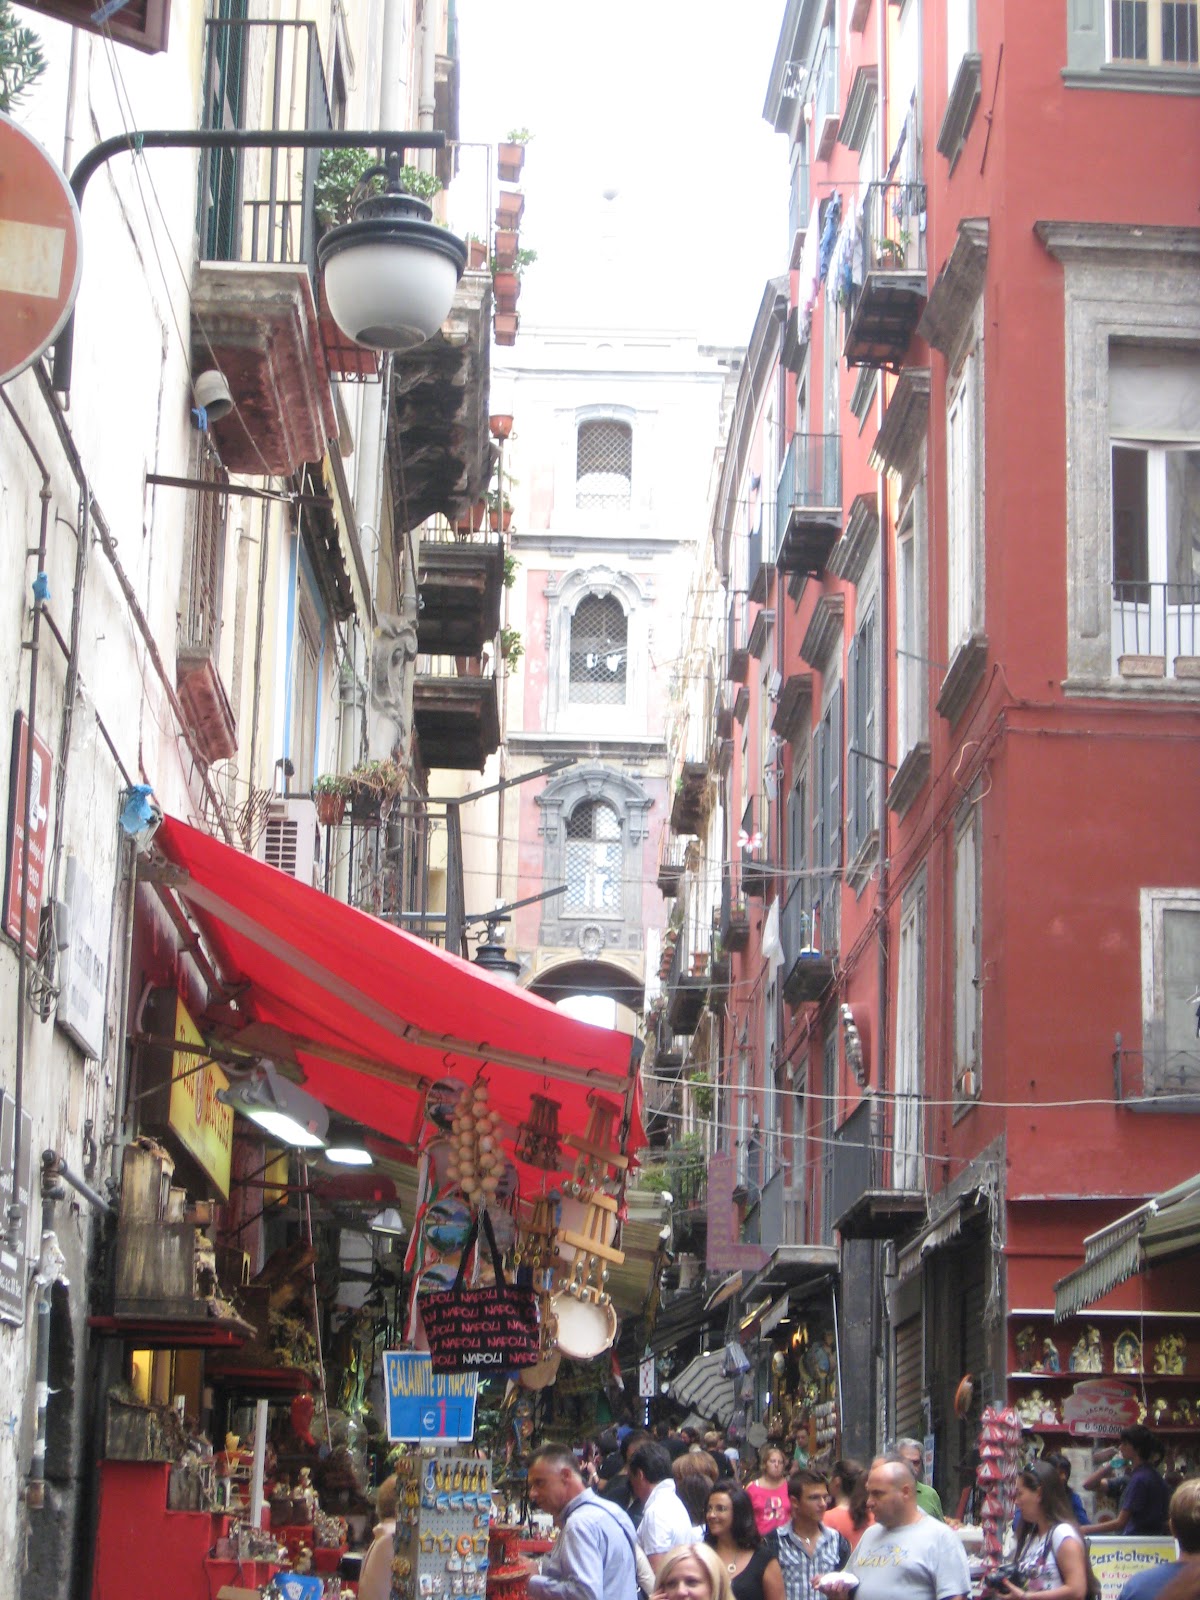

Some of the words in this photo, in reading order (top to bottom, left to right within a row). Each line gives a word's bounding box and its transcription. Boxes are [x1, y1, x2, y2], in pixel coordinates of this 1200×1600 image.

[461, 1321, 501, 1333] NAPOLI
[441, 1337, 481, 1349] NAPOLI
[487, 1336, 527, 1348] NAPOLI
[462, 1351, 503, 1364] NAPOLI
[390, 1359, 435, 1397] CALAMITE
[1086, 1406, 1118, 1417] JACKPOT
